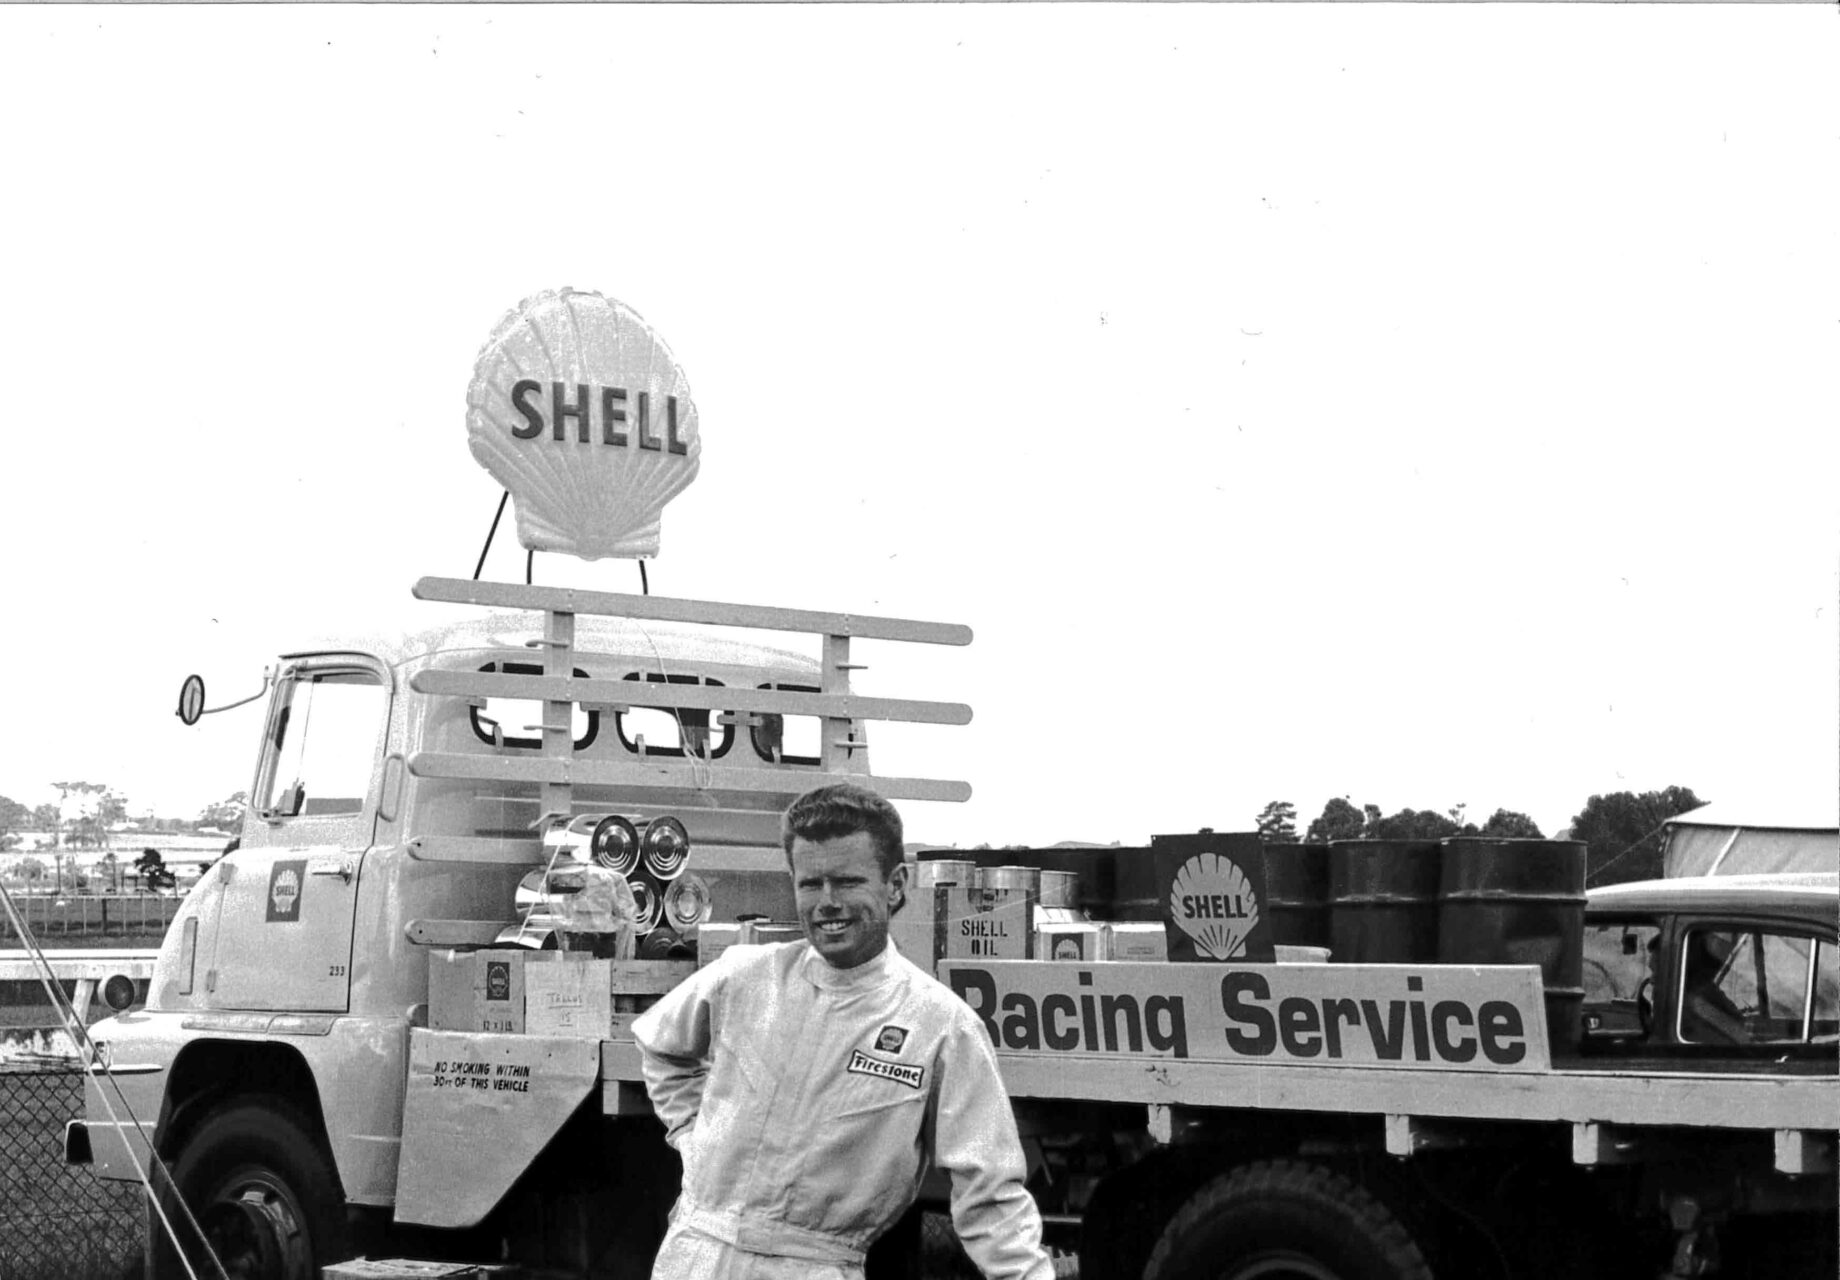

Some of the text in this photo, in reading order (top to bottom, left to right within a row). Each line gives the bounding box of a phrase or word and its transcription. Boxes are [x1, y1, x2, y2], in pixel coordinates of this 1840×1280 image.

[511, 379, 687, 456] SHELL
[275, 885, 295, 896] SHELL
[1182, 894, 1248, 919] SHELL
[961, 919, 1008, 937] SHELL
[971, 939, 998, 956] OIL
[1058, 951, 1077, 960] SHELL
[1220, 970, 1527, 1064] Service
[434, 1061, 530, 1078] NO SMOKING WITHIN
[855, 1056, 919, 1082] Firestone
[455, 1076, 466, 1088] OF
[471, 1077, 489, 1090] THIS
[493, 1078, 529, 1092] VEHICLE
